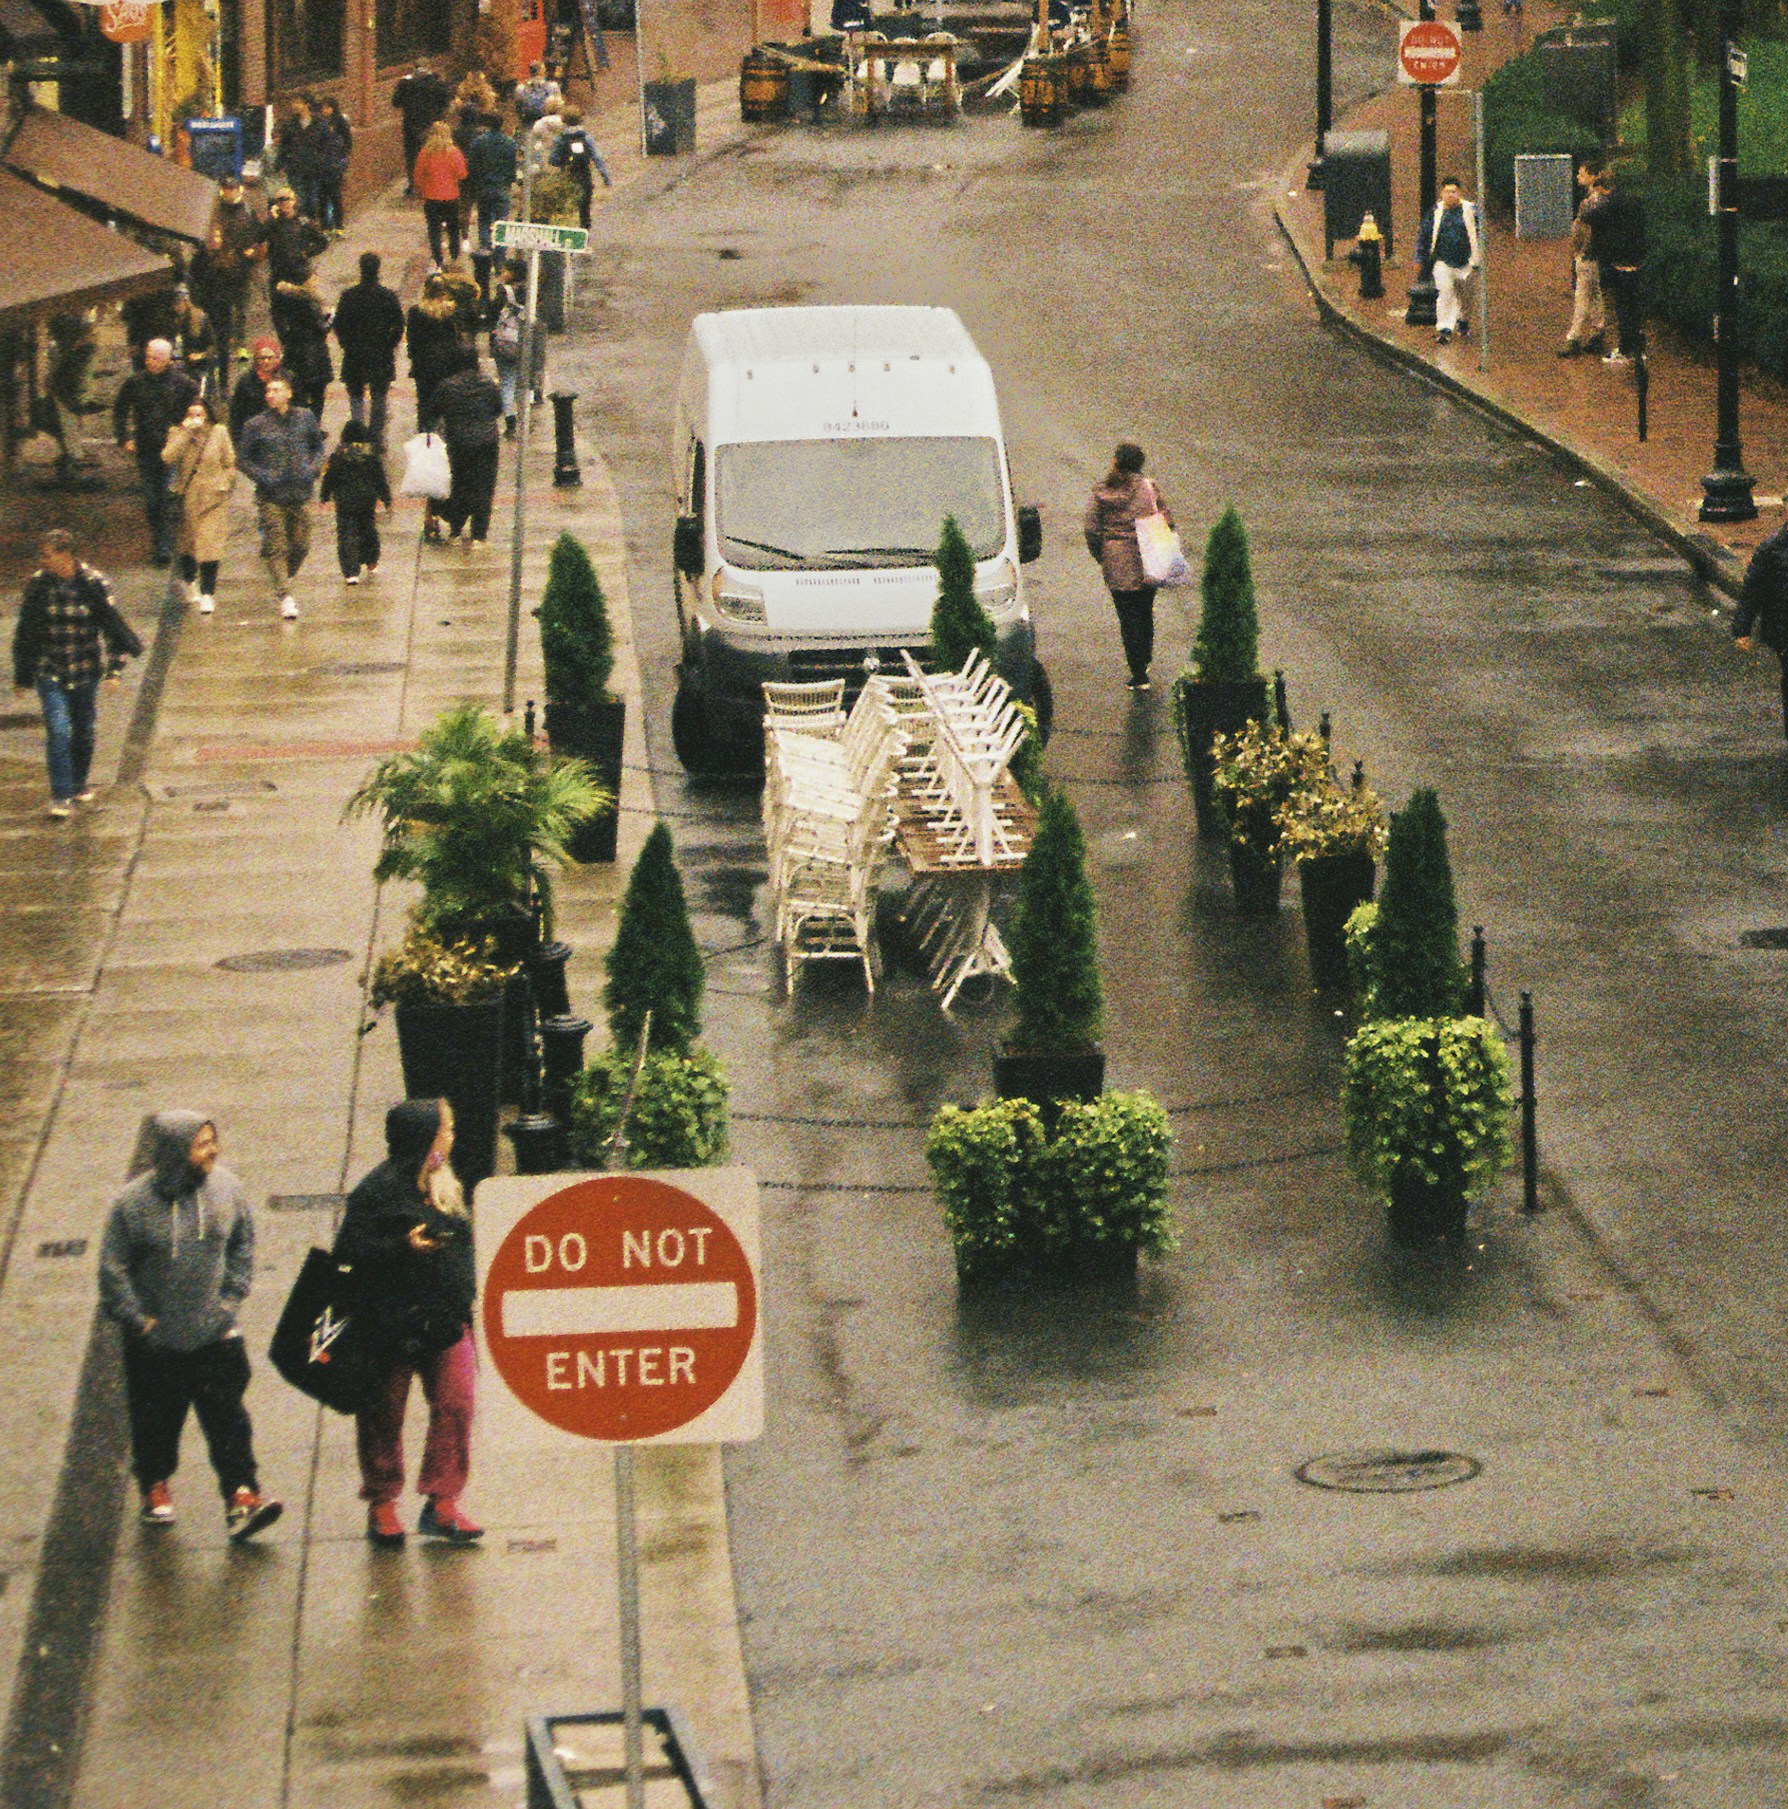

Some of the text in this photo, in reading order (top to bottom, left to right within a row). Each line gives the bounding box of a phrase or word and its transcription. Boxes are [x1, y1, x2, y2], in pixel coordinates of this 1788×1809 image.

[524, 1227, 713, 1274] DO NOT
[546, 1347, 696, 1391] ENTER
